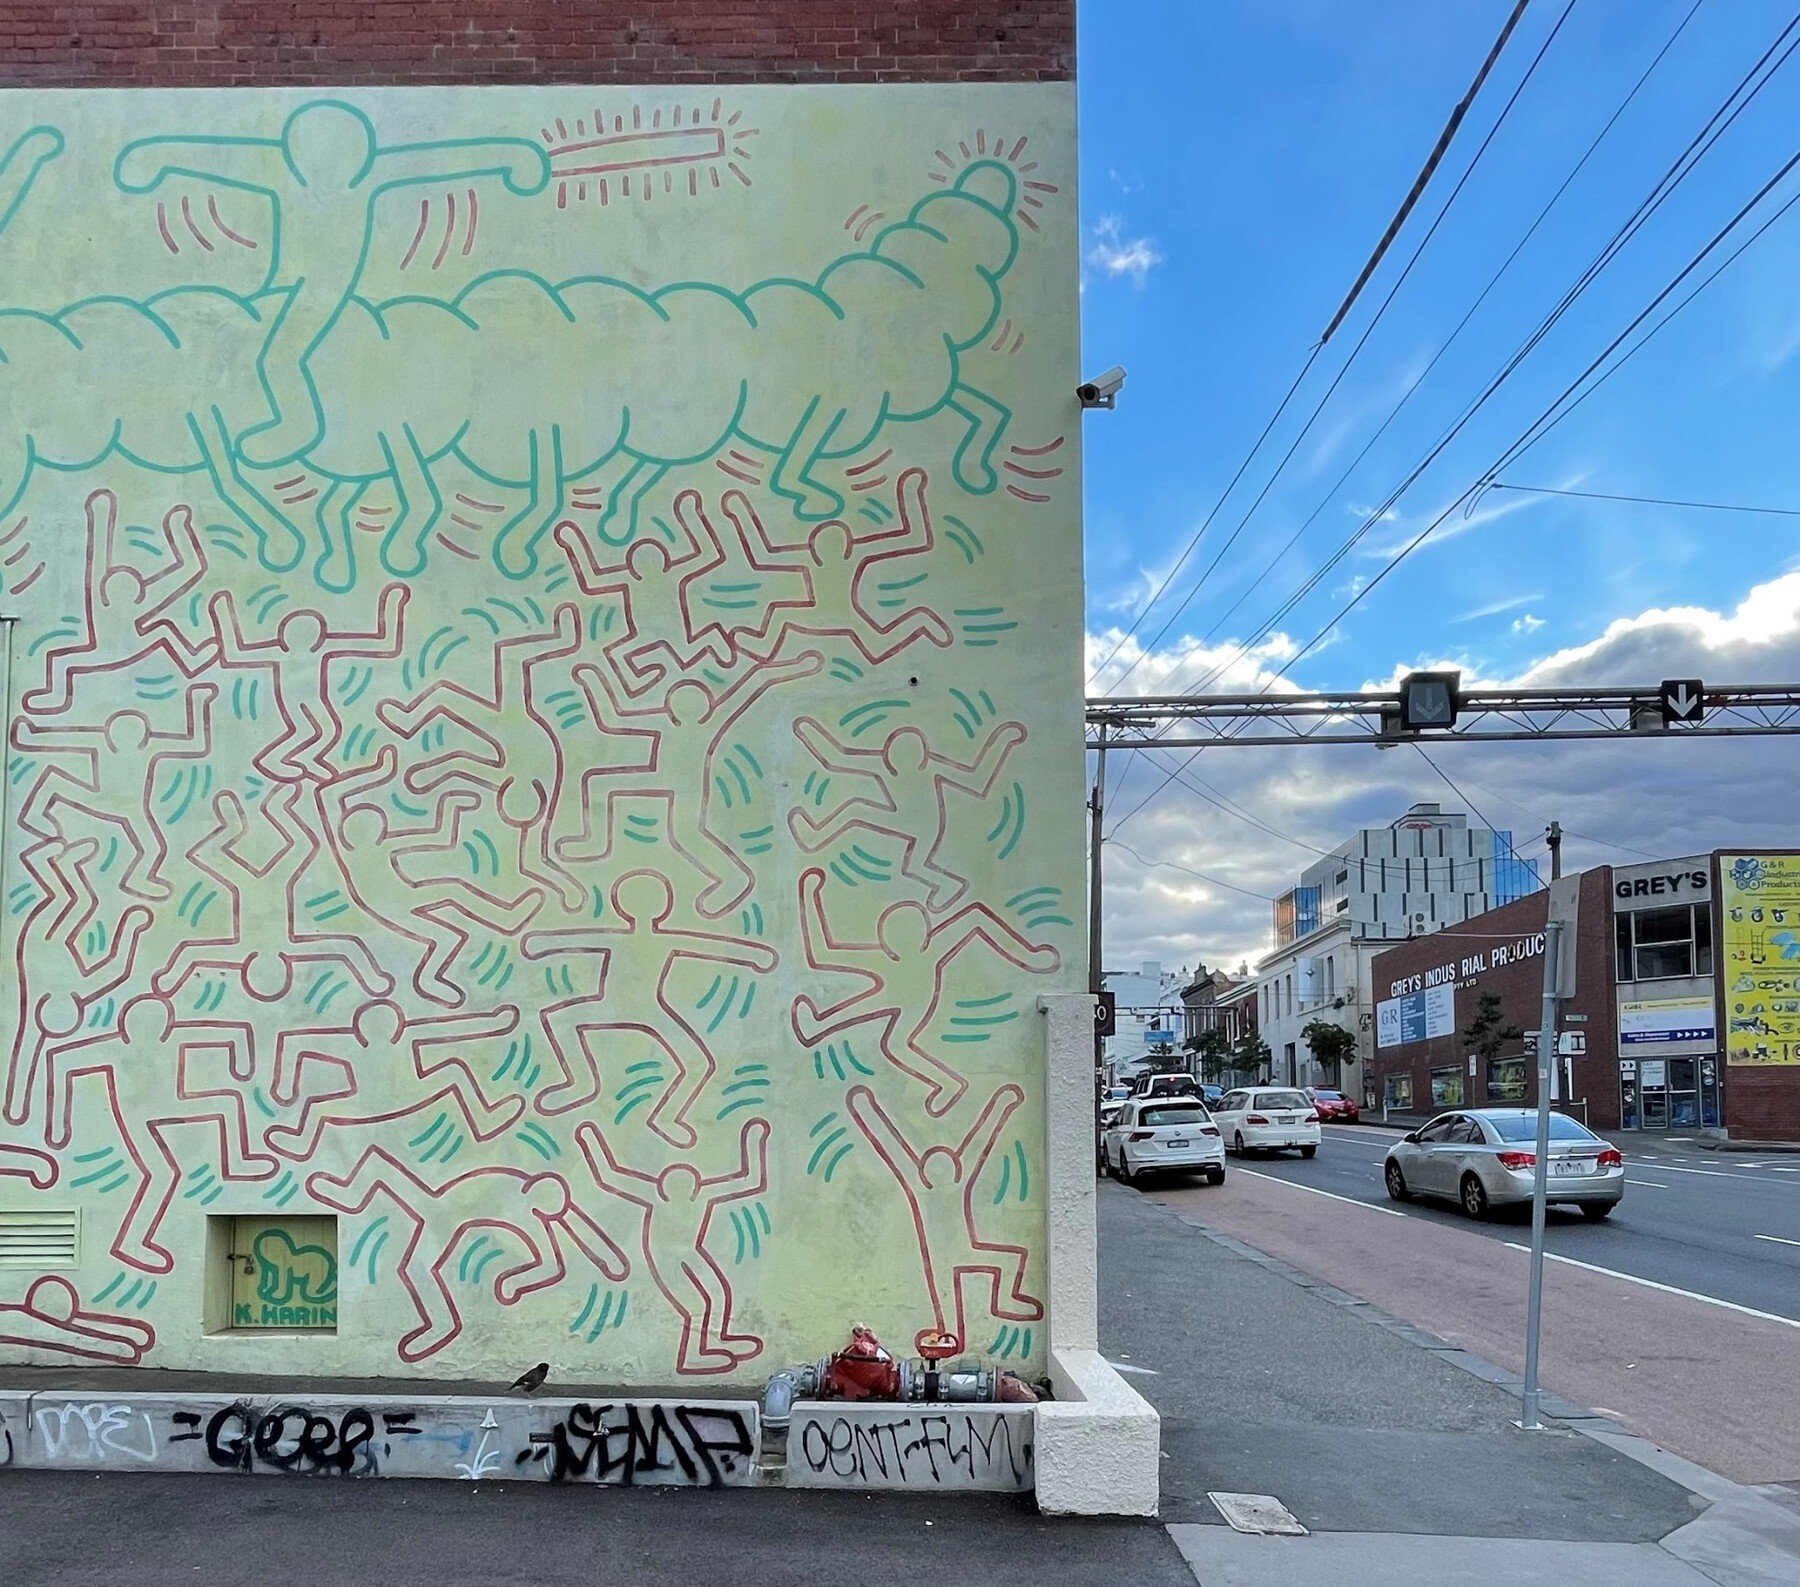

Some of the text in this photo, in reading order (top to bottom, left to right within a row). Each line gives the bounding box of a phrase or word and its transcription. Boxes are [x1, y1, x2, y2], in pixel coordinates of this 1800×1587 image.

[1616, 871, 1707, 898] GREY'S
[1391, 974, 1422, 997] GREY'S
[1491, 932, 1548, 968] PRODUC
